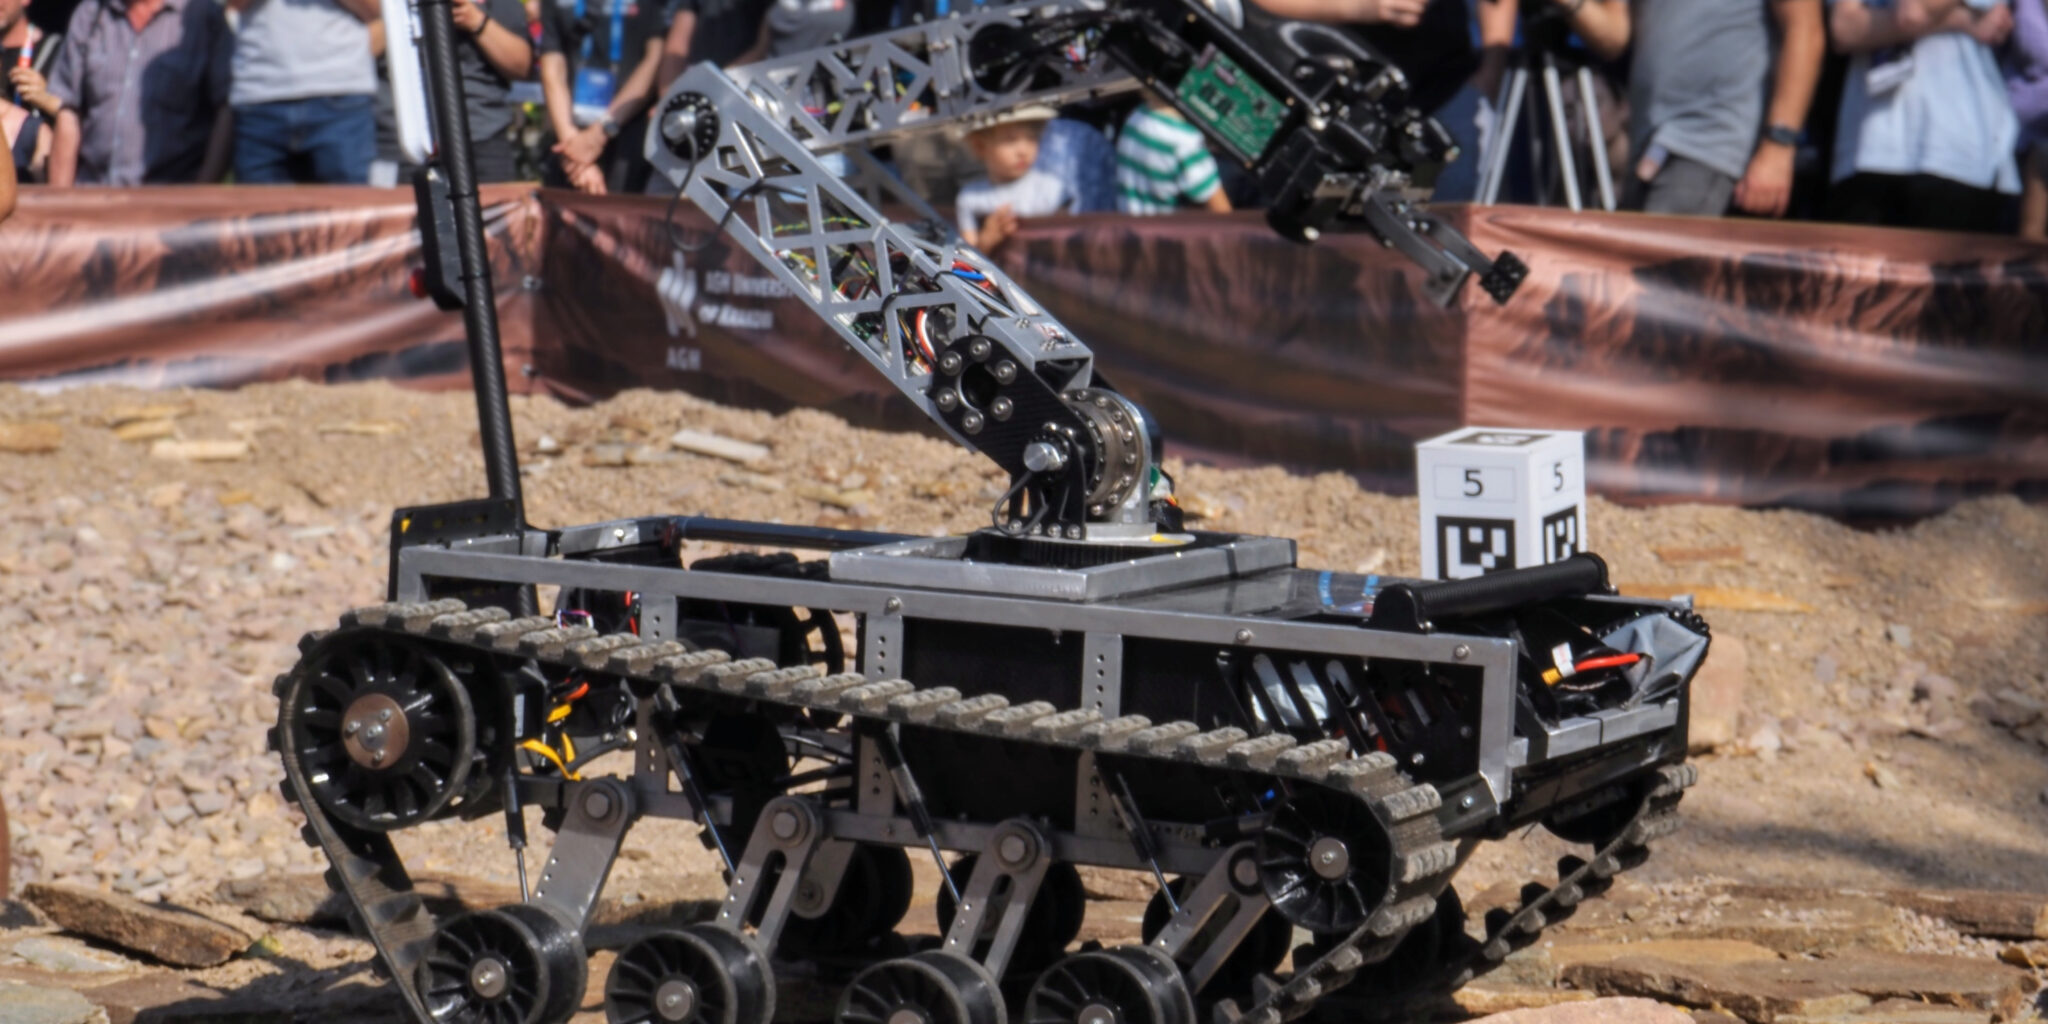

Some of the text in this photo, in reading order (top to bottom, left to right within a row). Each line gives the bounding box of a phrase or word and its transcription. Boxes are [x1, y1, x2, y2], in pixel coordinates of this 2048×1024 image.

[666, 347, 701, 371] AGH
[1463, 469, 1484, 497] 5
[1553, 462, 1564, 491] 5
